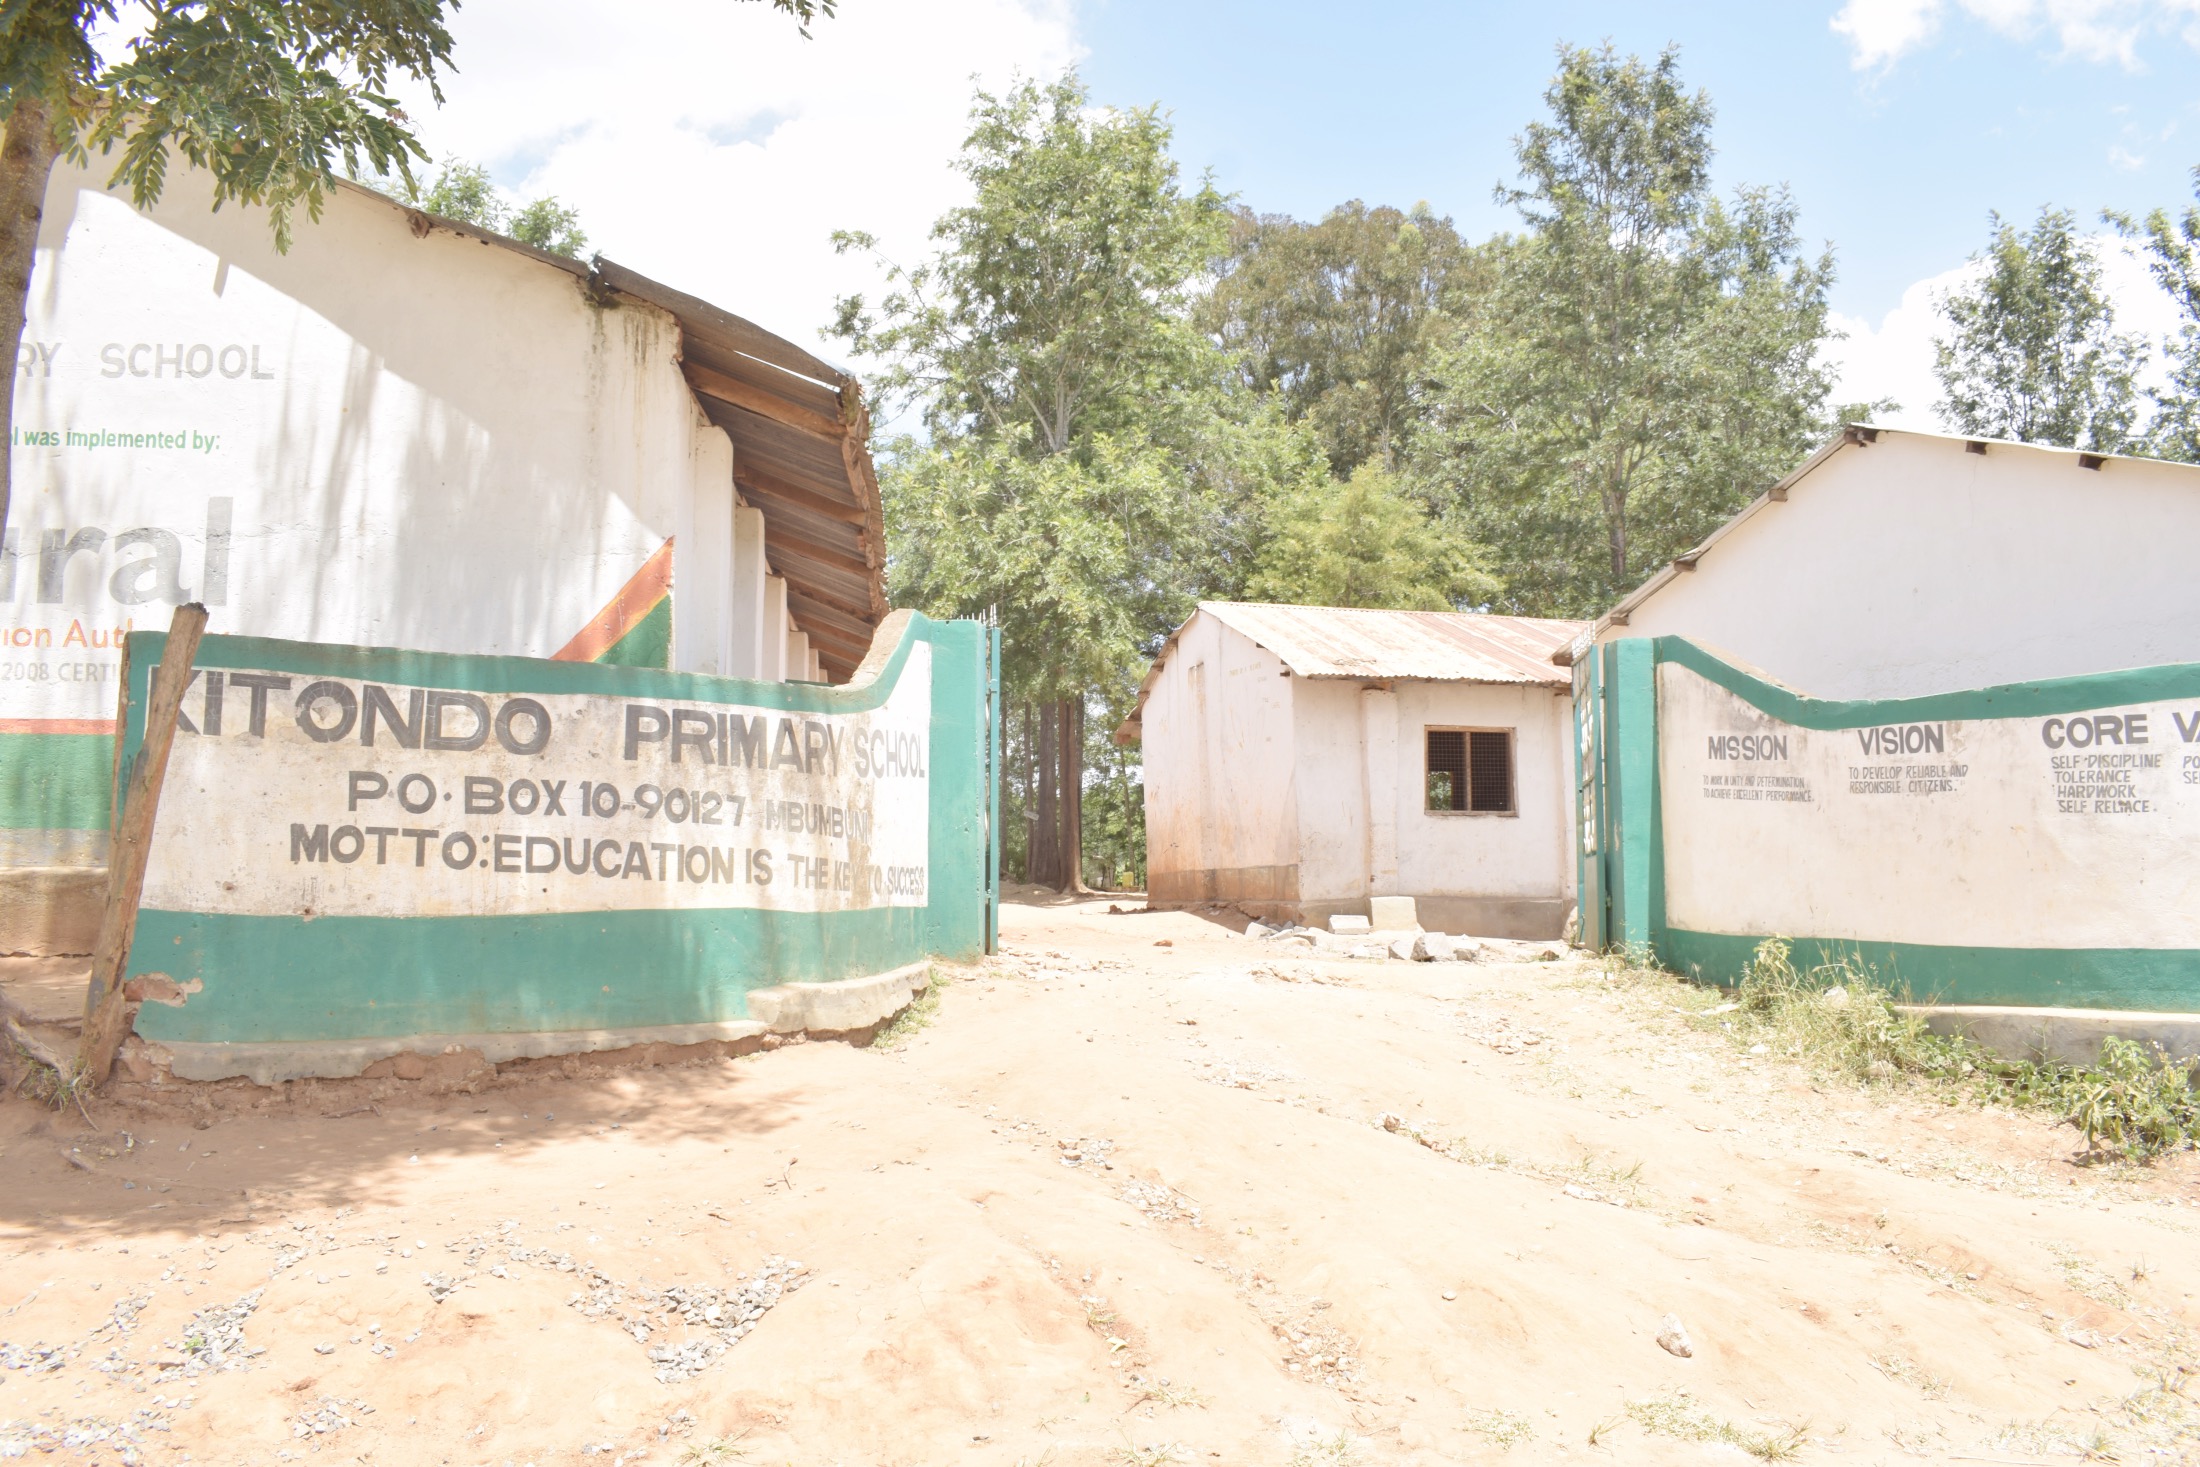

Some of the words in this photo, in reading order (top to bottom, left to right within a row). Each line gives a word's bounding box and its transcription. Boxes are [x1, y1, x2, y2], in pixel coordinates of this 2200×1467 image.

[101, 343, 275, 380] SCHOOL
[24, 431, 60, 446] was
[67, 429, 187, 450] implemented
[193, 430, 221, 454] by:
[624, 704, 844, 777] PRIMARY
[853, 727, 926, 778] SCHOOL
[1857, 724, 1944, 755] VISION
[2042, 714, 2148, 749] CORE
[1708, 735, 1788, 761] MISSION
[1849, 766, 1859, 779] TO
[1863, 766, 1902, 779] DEVELOP
[1906, 765, 1946, 779] RELIABLE
[1950, 764, 1968, 778] AND
[2055, 770, 2131, 783] TOLERANCE
[1850, 780, 1901, 793] RESPONSIBLE
[2058, 785, 2136, 798] HARDWORK
[465, 776, 567, 816] BOX
[579, 780, 746, 827] 10-90127
[2058, 800, 2087, 813] SELF
[746, 848, 774, 886] IS
[787, 854, 829, 890] THE
[865, 865, 882, 895] TO
[887, 866, 925, 896] SUCCESS
